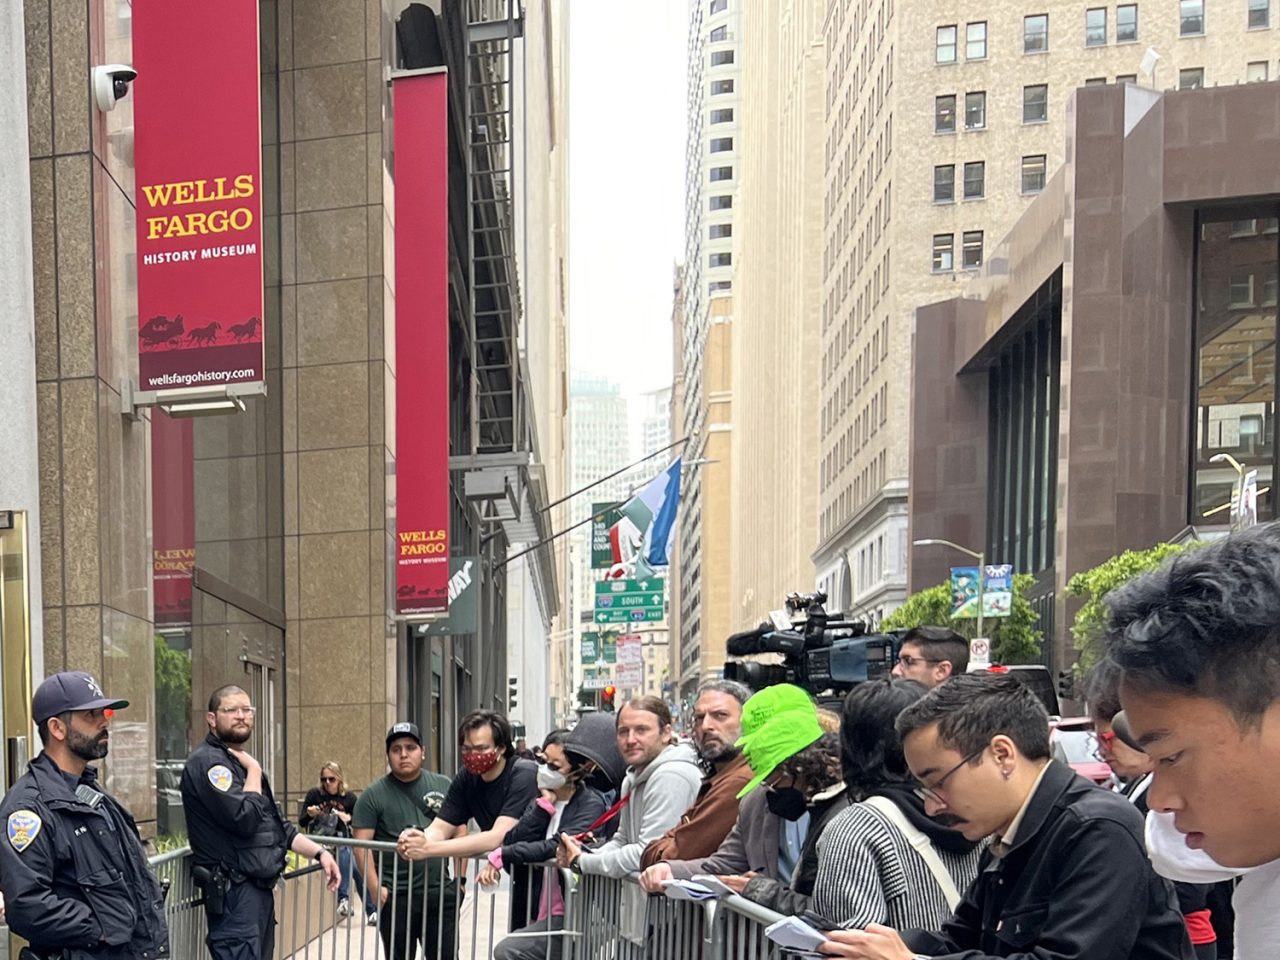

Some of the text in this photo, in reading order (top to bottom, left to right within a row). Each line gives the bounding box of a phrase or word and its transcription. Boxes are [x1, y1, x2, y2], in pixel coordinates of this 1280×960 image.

[142, 174, 255, 208] WELLS
[146, 207, 253, 240] FARGO
[143, 243, 257, 265] HISTORY MUSEUM
[148, 367, 255, 387] wellsfargohistory.com
[399, 529, 446, 543] WELLS
[400, 542, 446, 556] FARGO
